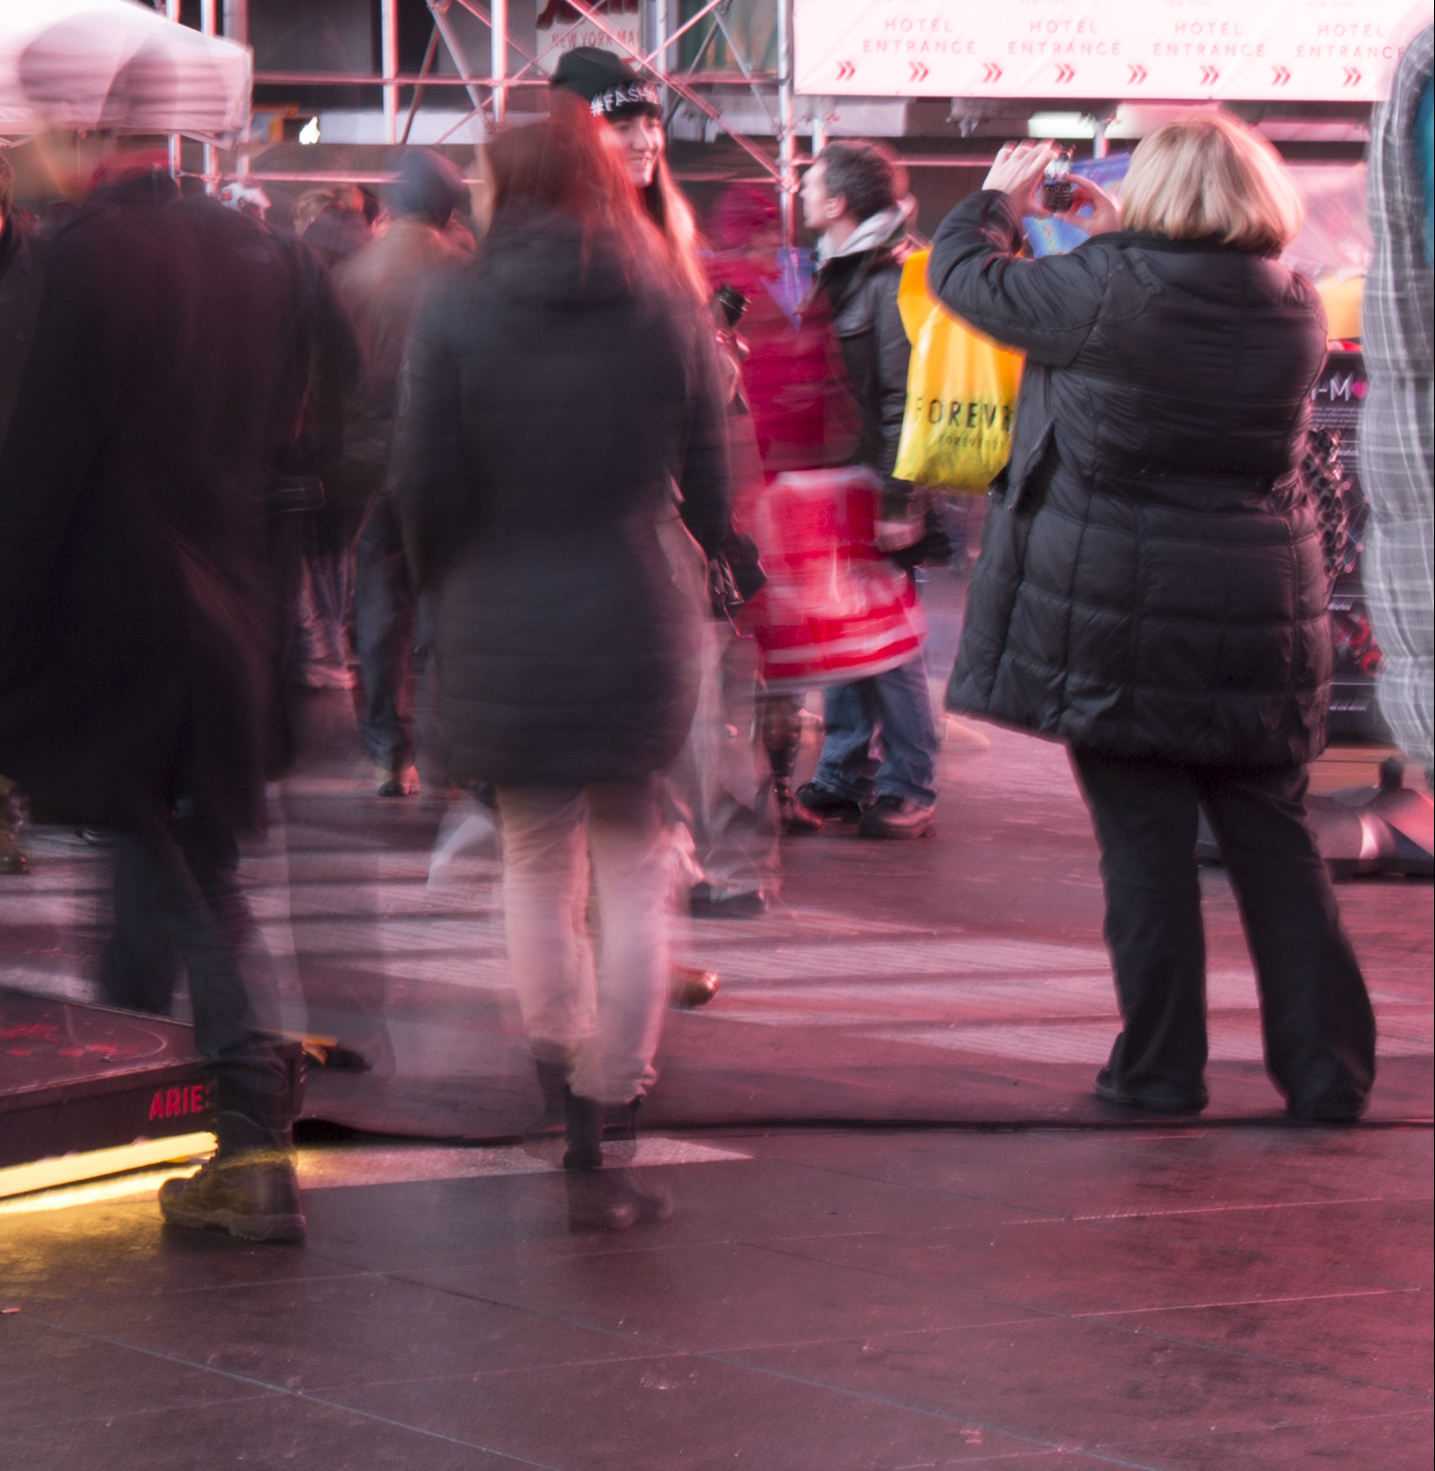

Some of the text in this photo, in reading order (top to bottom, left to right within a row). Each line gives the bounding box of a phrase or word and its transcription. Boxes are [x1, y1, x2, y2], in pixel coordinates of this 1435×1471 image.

[884, 19, 954, 33] HOTEL
[1029, 21, 1099, 35] HOTEL
[1174, 22, 1244, 36] HOTEL
[1317, 24, 1386, 38] HOTEL
[862, 40, 977, 55] ENTRANCE
[1008, 42, 1121, 56] ENTRANCE
[1153, 43, 1266, 58] ENTRANCE
[1296, 45, 1405, 60] ENTRANCE
[149, 1083, 212, 1122] ARIE
